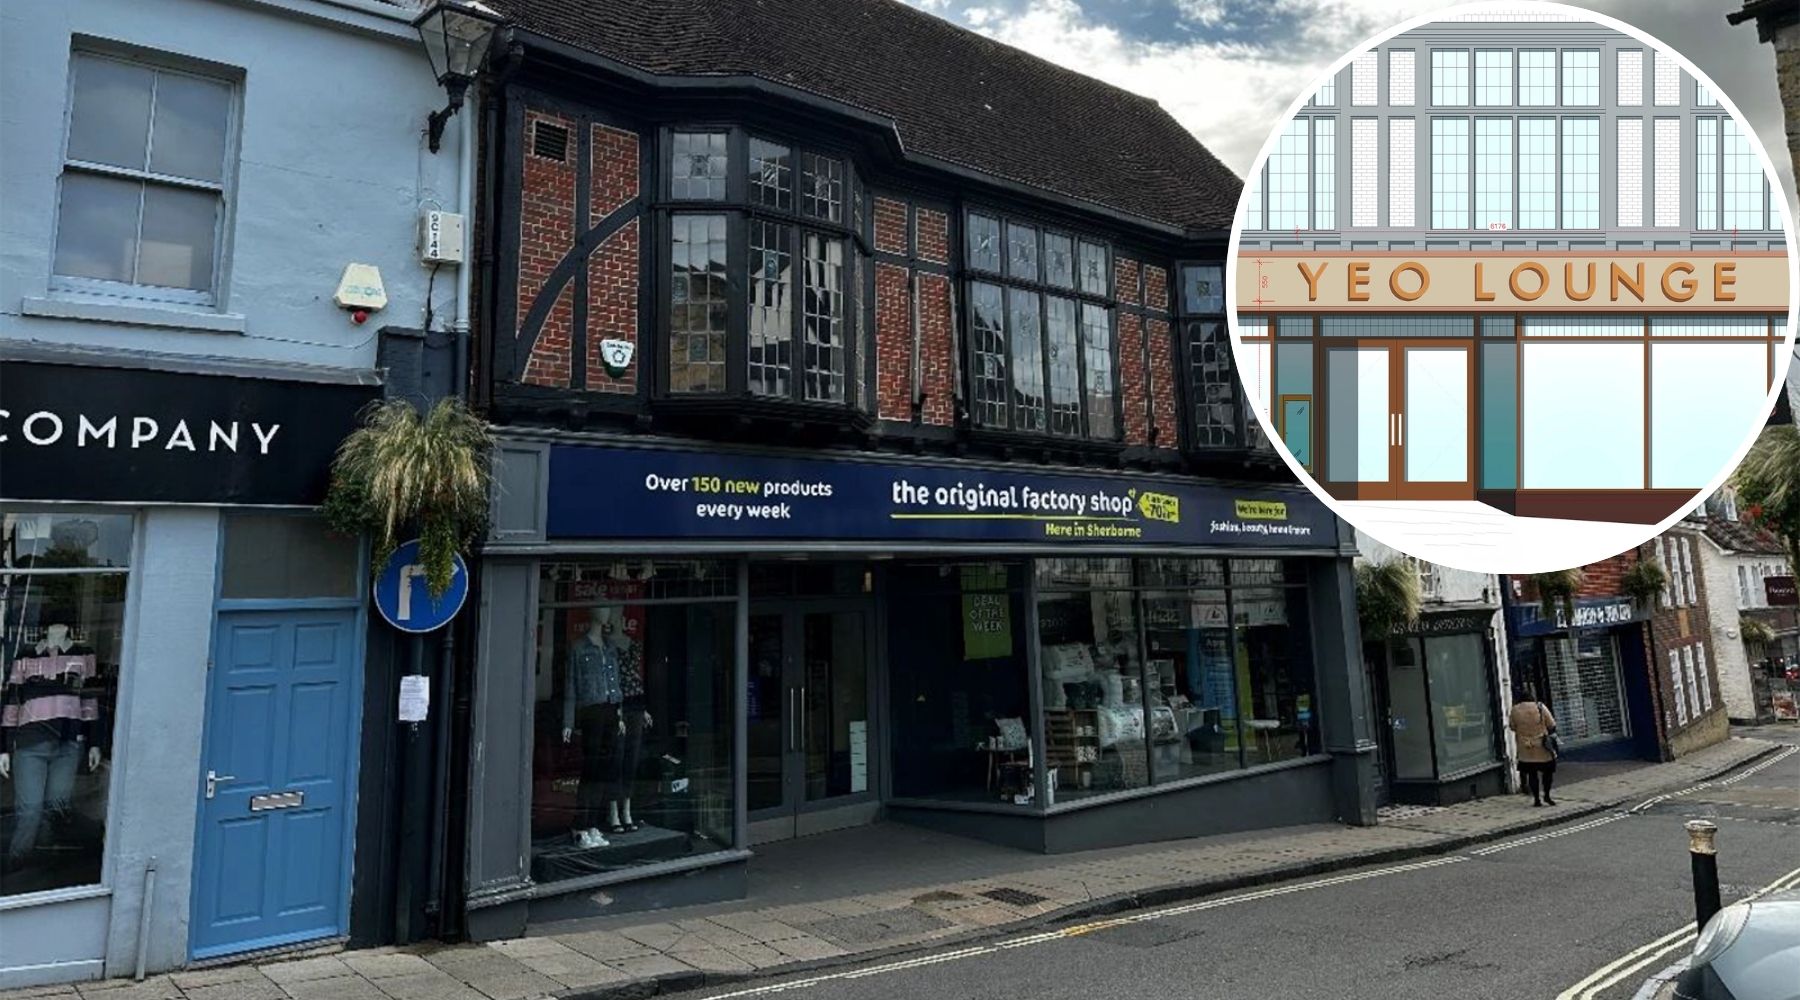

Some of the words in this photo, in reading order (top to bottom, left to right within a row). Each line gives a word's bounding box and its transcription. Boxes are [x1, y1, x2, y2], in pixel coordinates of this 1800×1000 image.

[0, 409, 281, 454] OMPANY
[646, 474, 688, 491] Over
[691, 477, 721, 492] 150
[725, 480, 759, 493] new
[764, 480, 832, 498] products
[892, 480, 930, 505] the
[935, 482, 1018, 511] original
[1022, 486, 1086, 516] factory
[1091, 490, 1133, 517] shop
[696, 503, 743, 520] every
[747, 502, 791, 519] week
[1046, 523, 1072, 536] Here
[1074, 521, 1085, 536] in
[1087, 523, 1142, 538] Sherborne
